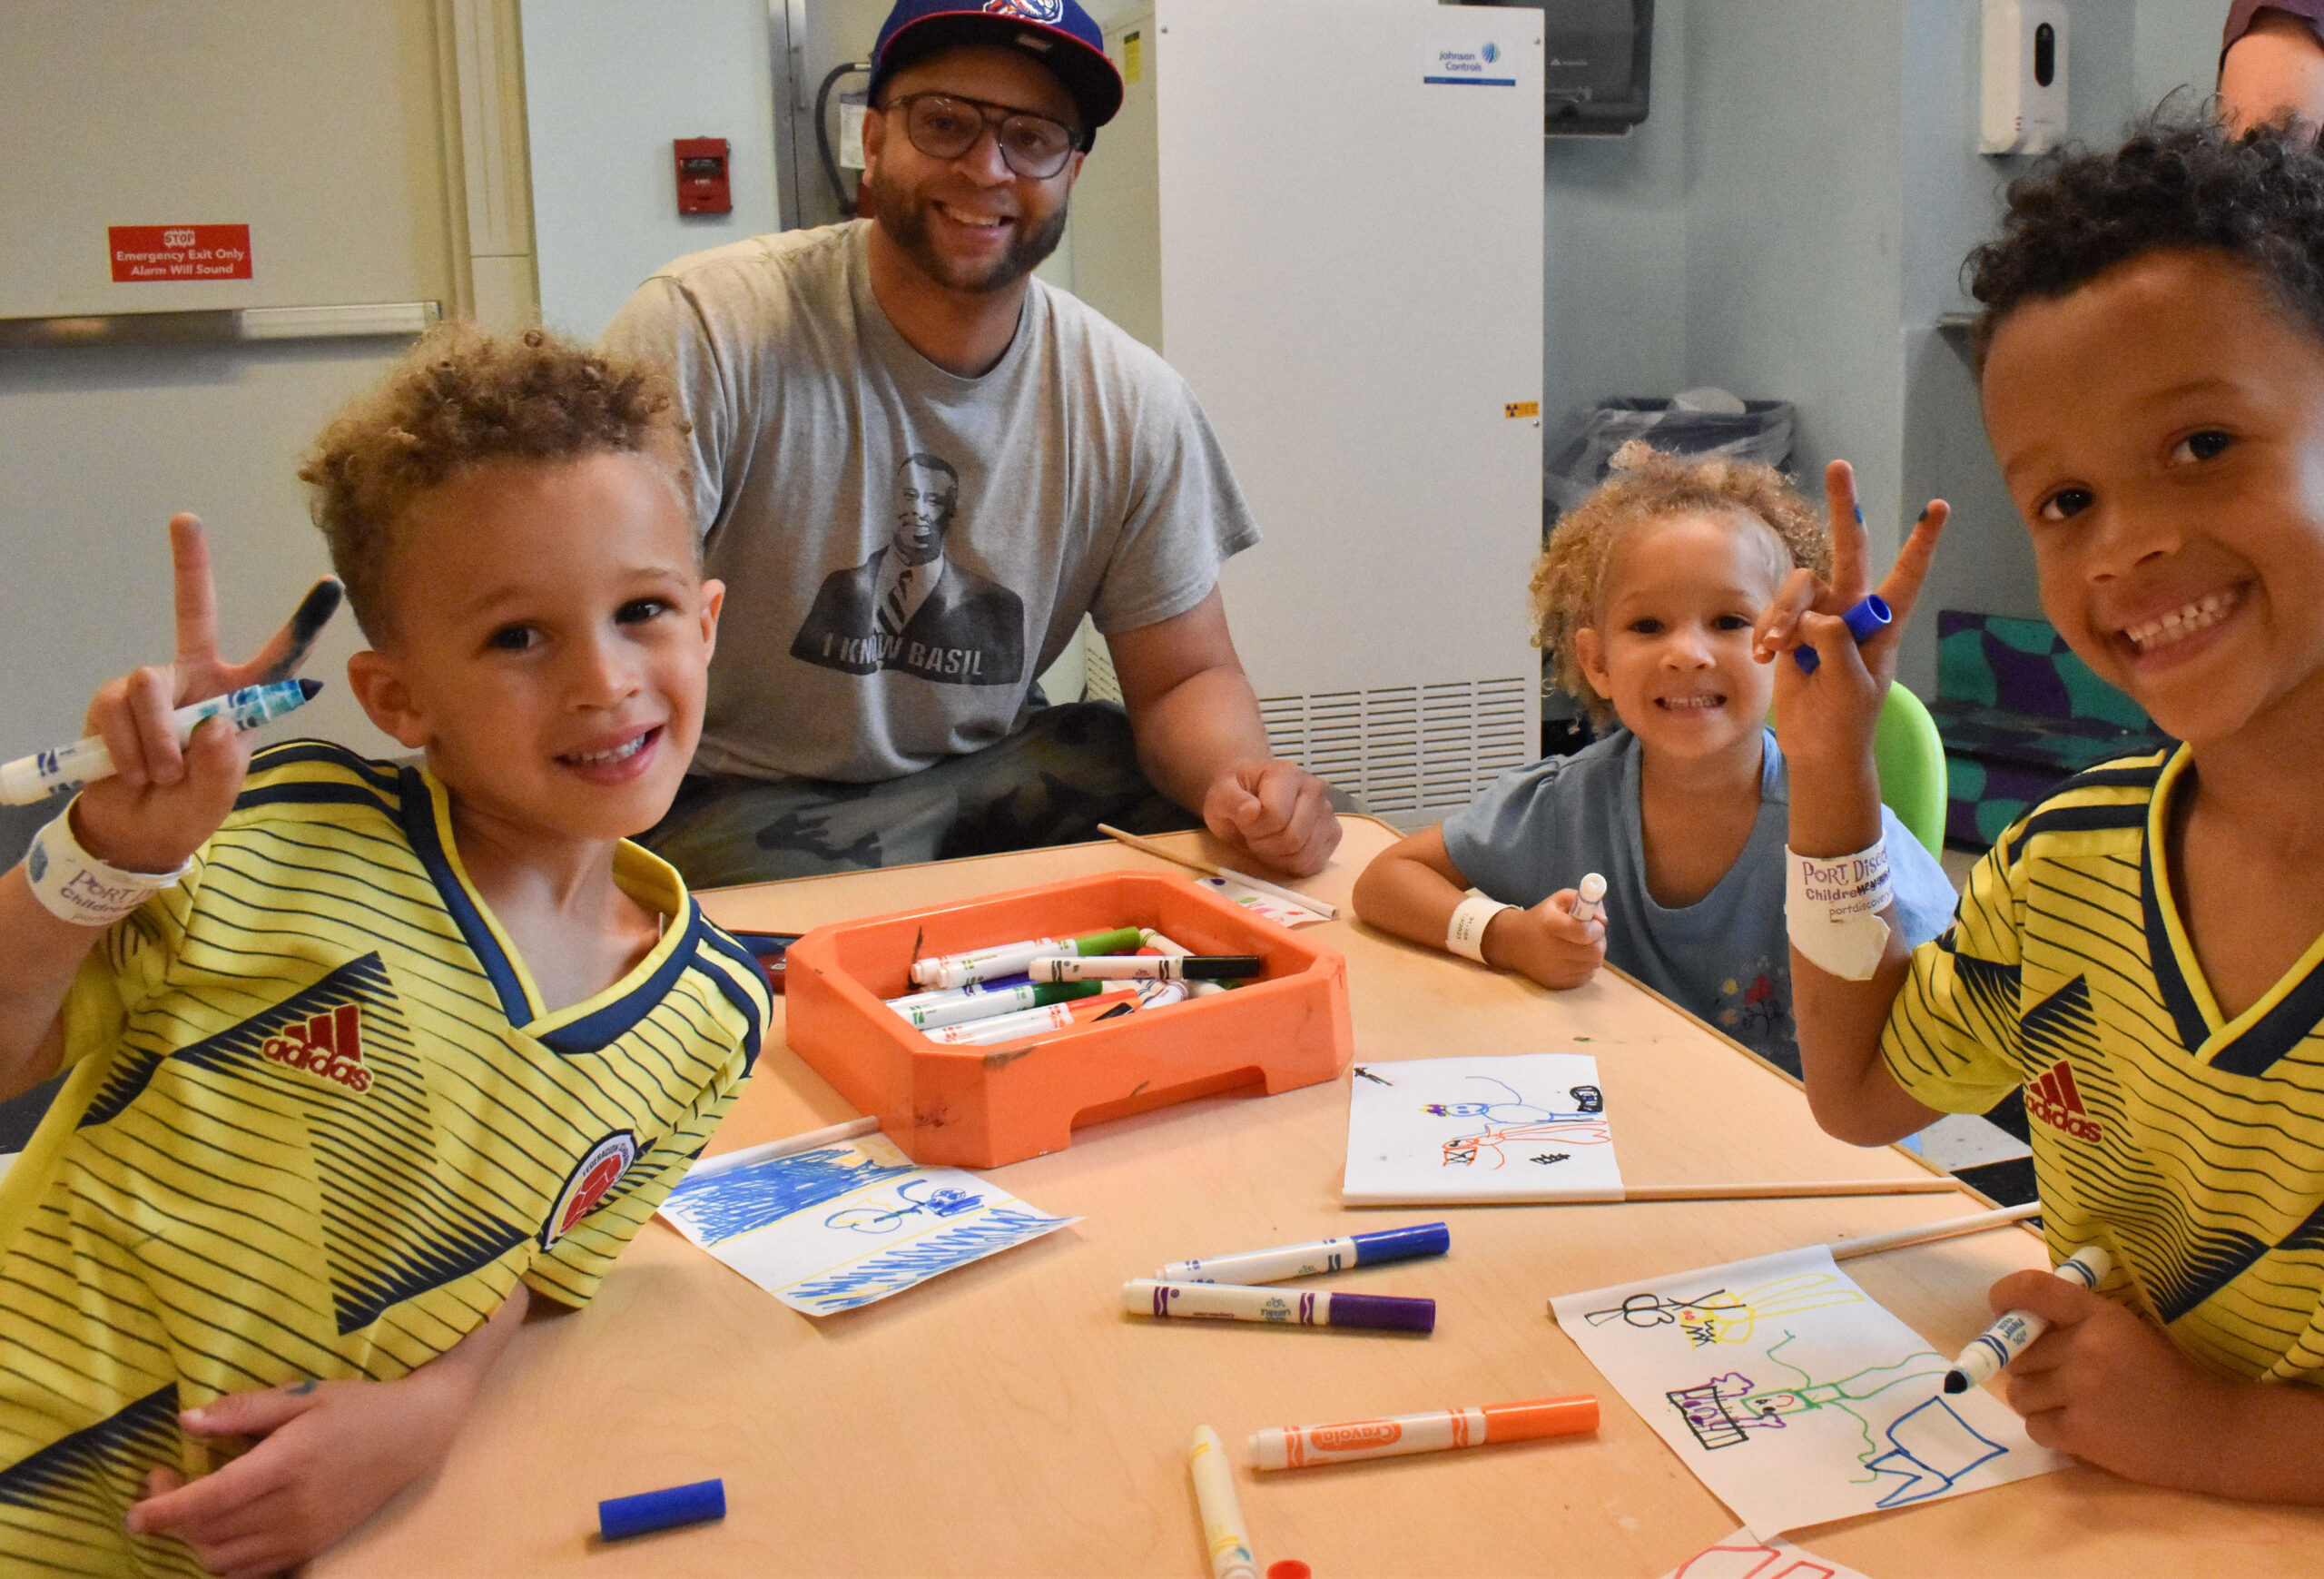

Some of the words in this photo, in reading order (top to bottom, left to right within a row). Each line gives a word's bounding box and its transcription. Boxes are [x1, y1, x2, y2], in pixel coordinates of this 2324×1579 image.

[1439, 51, 1475, 60] Johnson
[1445, 62, 1482, 71] Controls
[164, 233, 194, 243] STOP
[116, 251, 184, 262] Emergency
[188, 249, 212, 260] Exit
[216, 247, 244, 261] Only
[131, 265, 166, 276] Alarm
[170, 264, 193, 274] Will
[196, 263, 234, 273] Sound
[822, 632, 834, 656] I
[840, 635, 903, 664] KNOW
[909, 641, 983, 676] BASIL
[1802, 861, 1849, 885] PORT
[69, 869, 136, 903] PORT
[263, 1038, 373, 1092] adidas
[2026, 1094, 2102, 1143] adidas
[1321, 1424, 1395, 1446] Crayola
